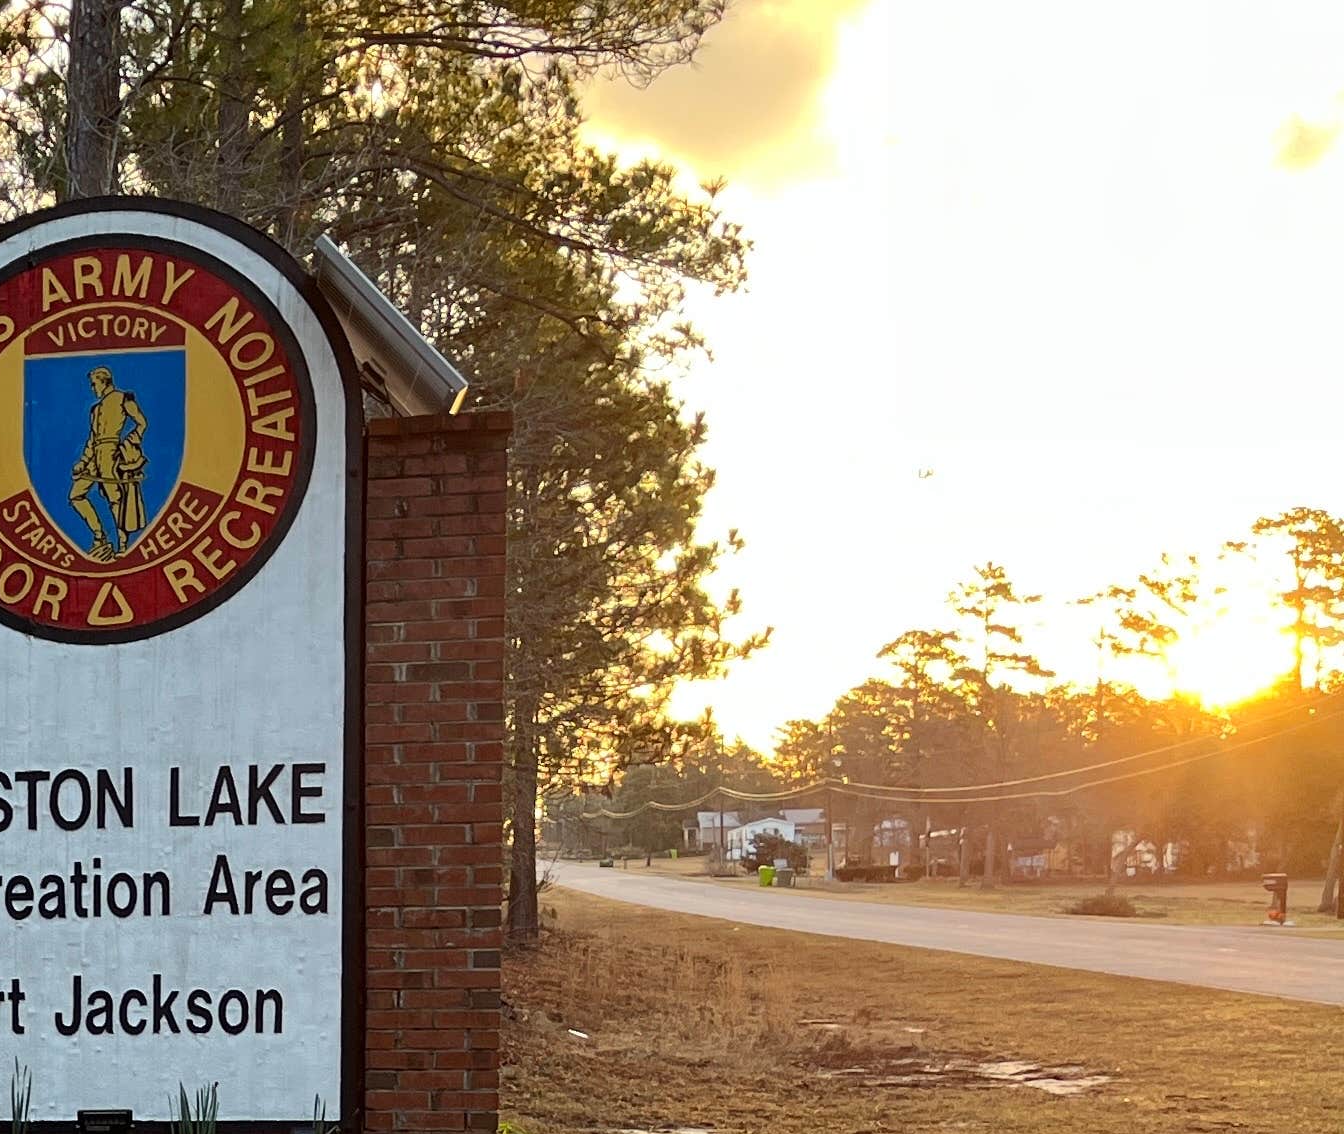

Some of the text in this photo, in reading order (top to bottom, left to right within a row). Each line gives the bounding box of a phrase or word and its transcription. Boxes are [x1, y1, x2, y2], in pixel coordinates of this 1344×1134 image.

[42, 254, 196, 312] ARMY
[47, 313, 167, 348] VICTORY
[163, 296, 296, 604] RECREATION
[2, 491, 210, 569] STARTS HERE
[169, 762, 327, 827] LAKE
[203, 854, 329, 916] Area
[54, 973, 284, 1037] Jackson
